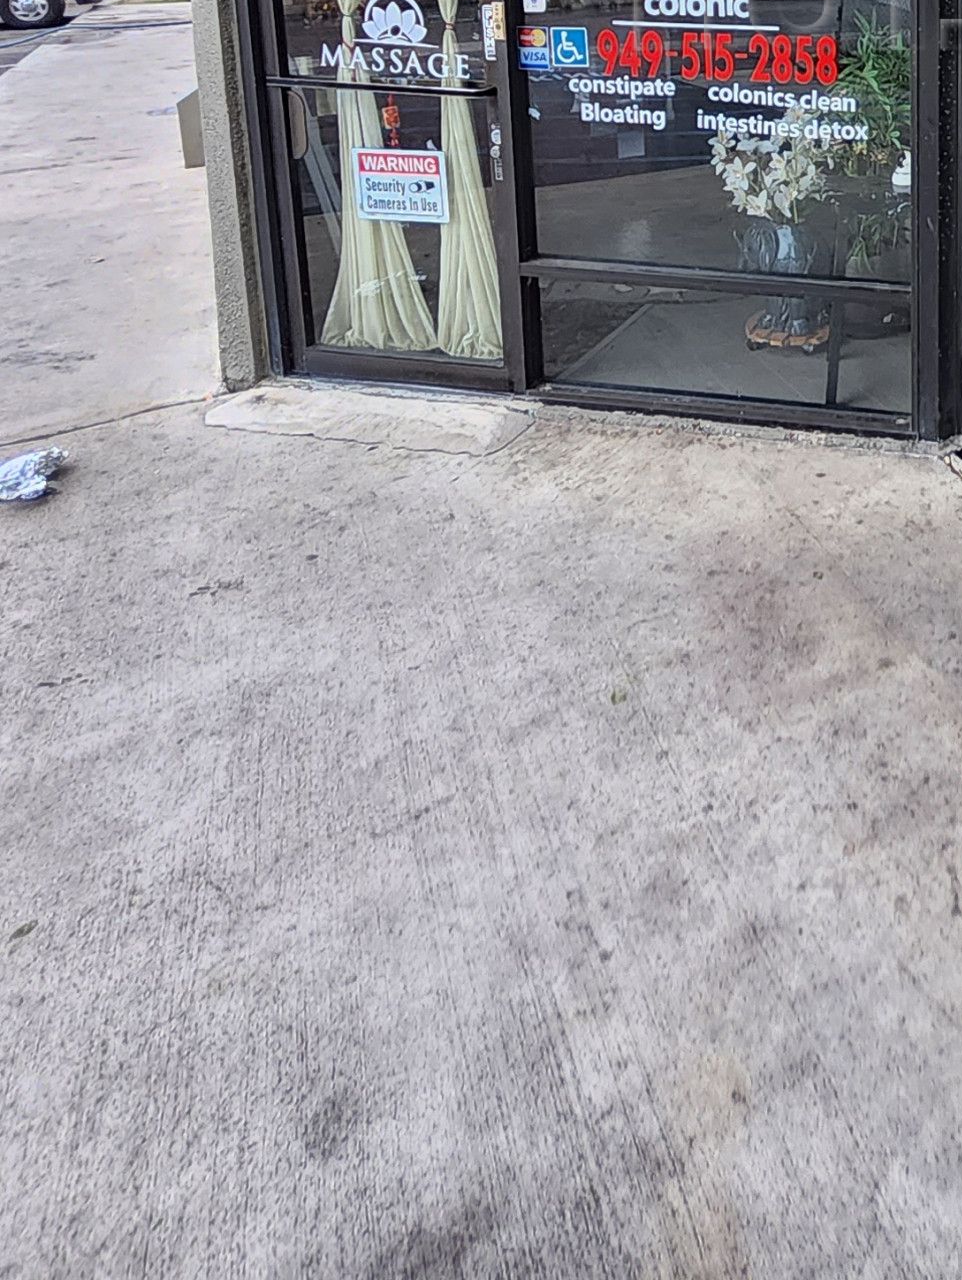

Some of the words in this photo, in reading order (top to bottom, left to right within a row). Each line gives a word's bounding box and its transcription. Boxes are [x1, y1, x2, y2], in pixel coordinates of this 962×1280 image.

[320, 42, 471, 80] MASSAGE
[522, 51, 548, 62] VISA
[596, 28, 838, 86] 949-515-2858
[569, 75, 676, 100] constipate
[708, 83, 798, 108] colonics
[800, 90, 857, 113] clean
[580, 102, 667, 131] Bloating
[696, 108, 804, 138] intestines
[804, 119, 869, 141] detox
[361, 155, 437, 173] WARNING
[365, 177, 405, 196] Security
[367, 194, 408, 211] Cameras
[409, 196, 419, 211] In
[421, 197, 438, 212] Use
